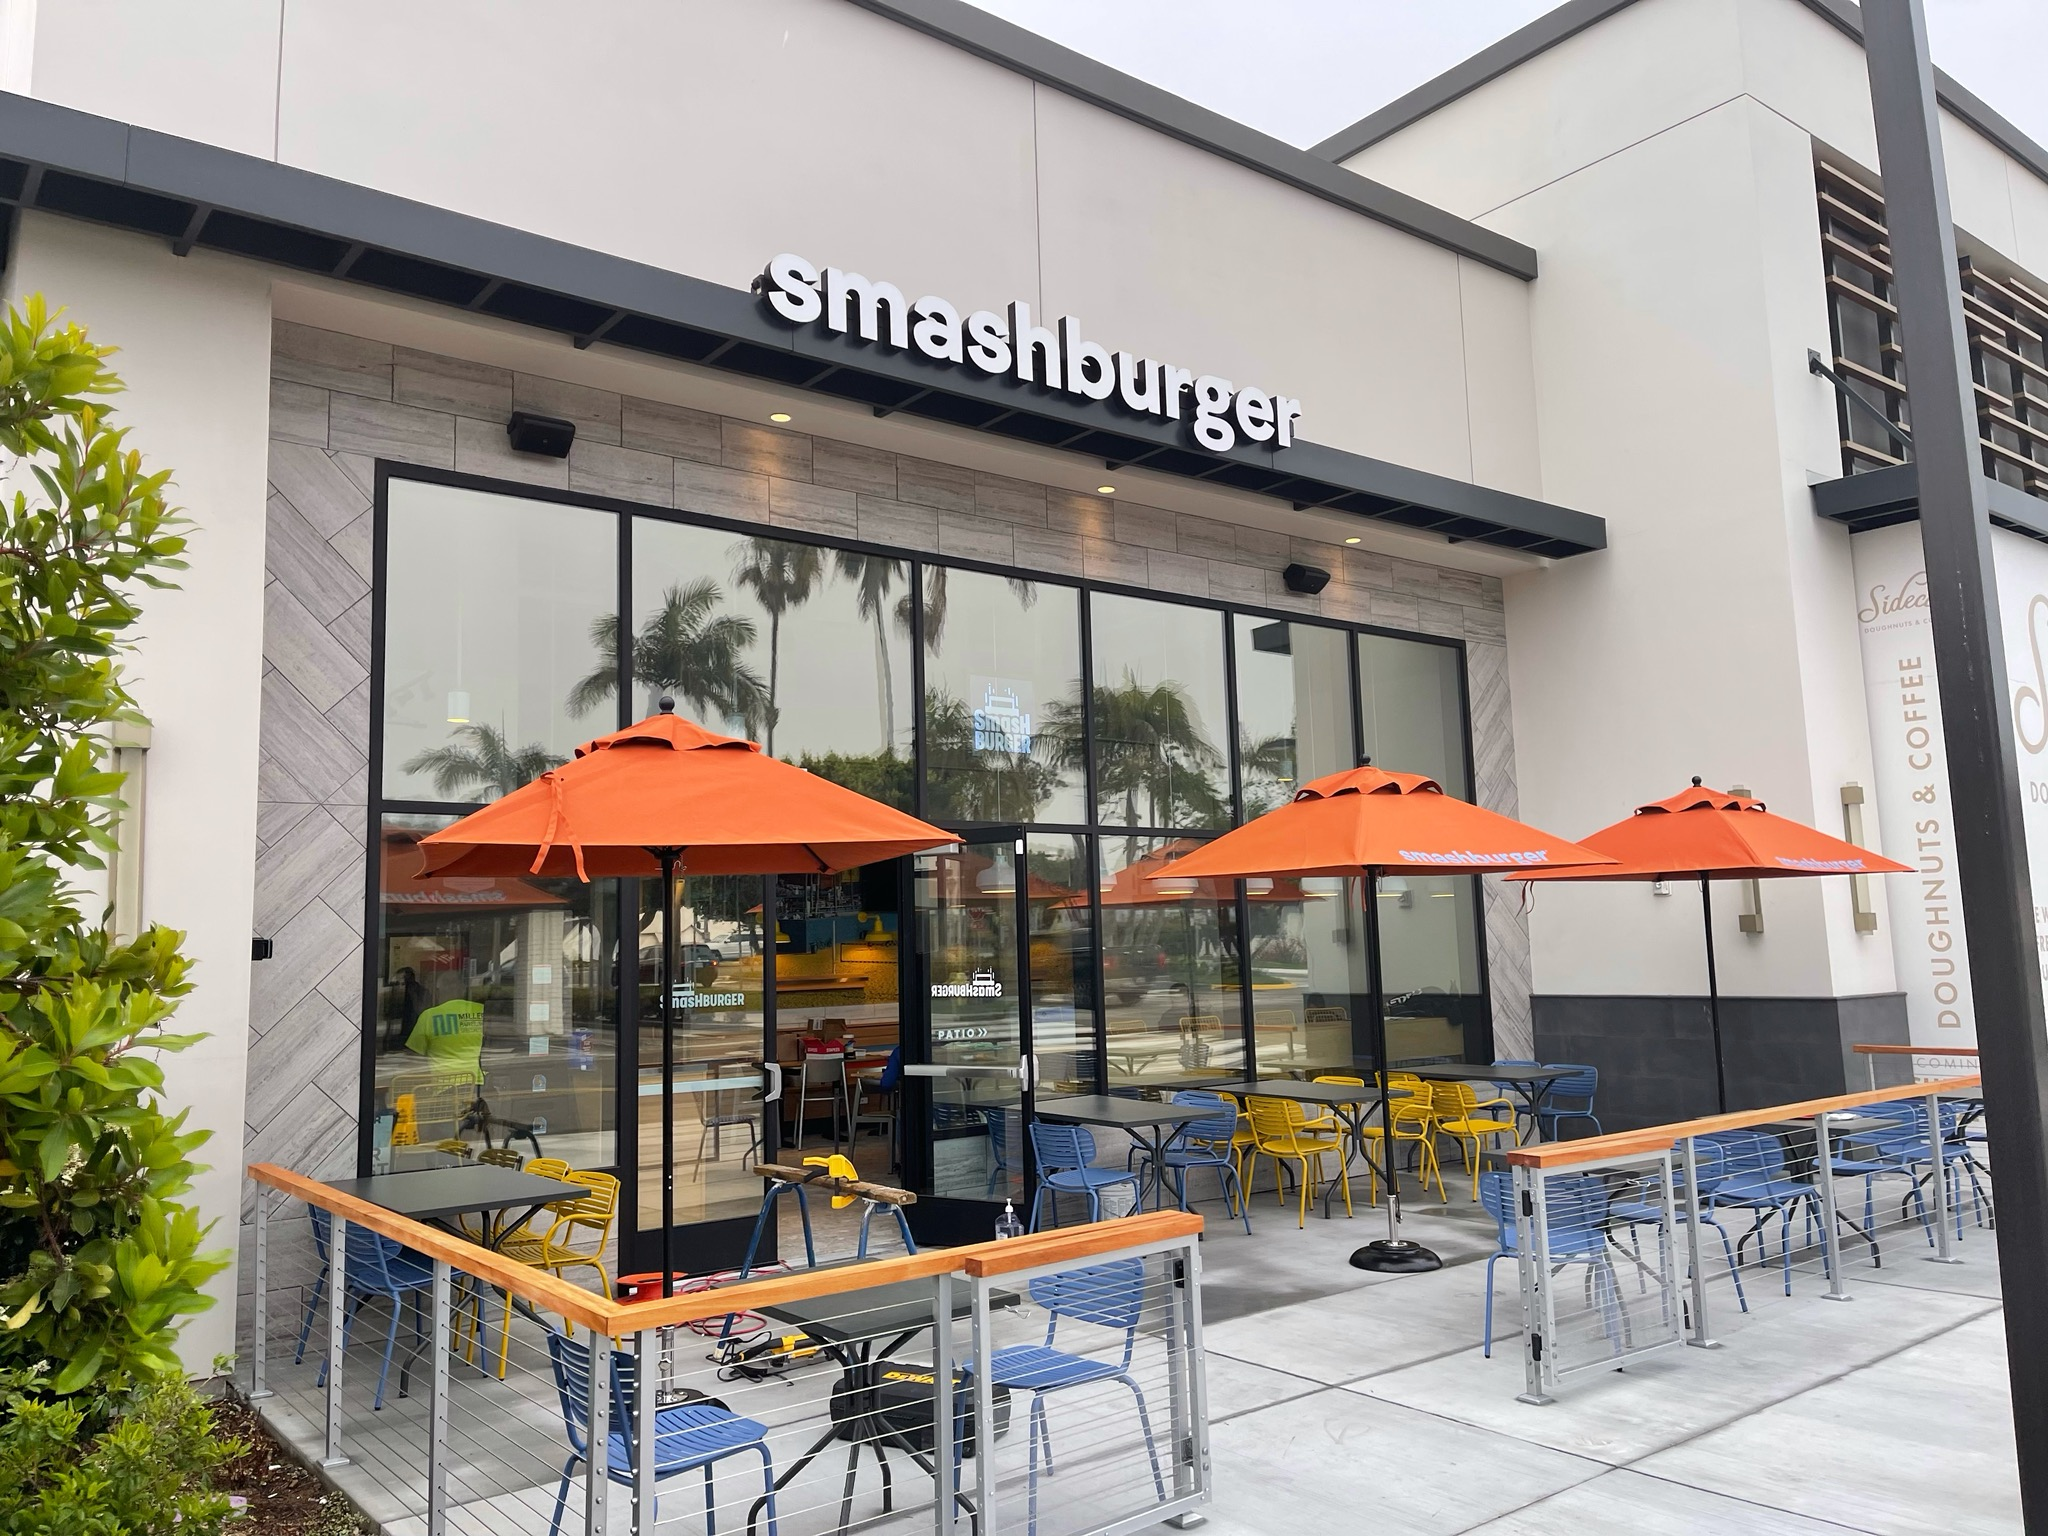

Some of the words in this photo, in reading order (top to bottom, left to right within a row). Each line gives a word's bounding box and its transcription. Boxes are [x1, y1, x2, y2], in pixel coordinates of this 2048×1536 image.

[767, 252, 1302, 452] smashburger
[1864, 621, 1913, 634] DOUGHNUTS
[1898, 656, 1932, 770] COFFEE
[974, 731, 1031, 754] BURGER
[1912, 783, 1936, 804] &
[1398, 850, 1549, 865] smashburger
[1915, 819, 1962, 1029] DOUGHNUTS
[458, 1012, 484, 1020] MILLE
[938, 1028, 975, 1040] PATIO
